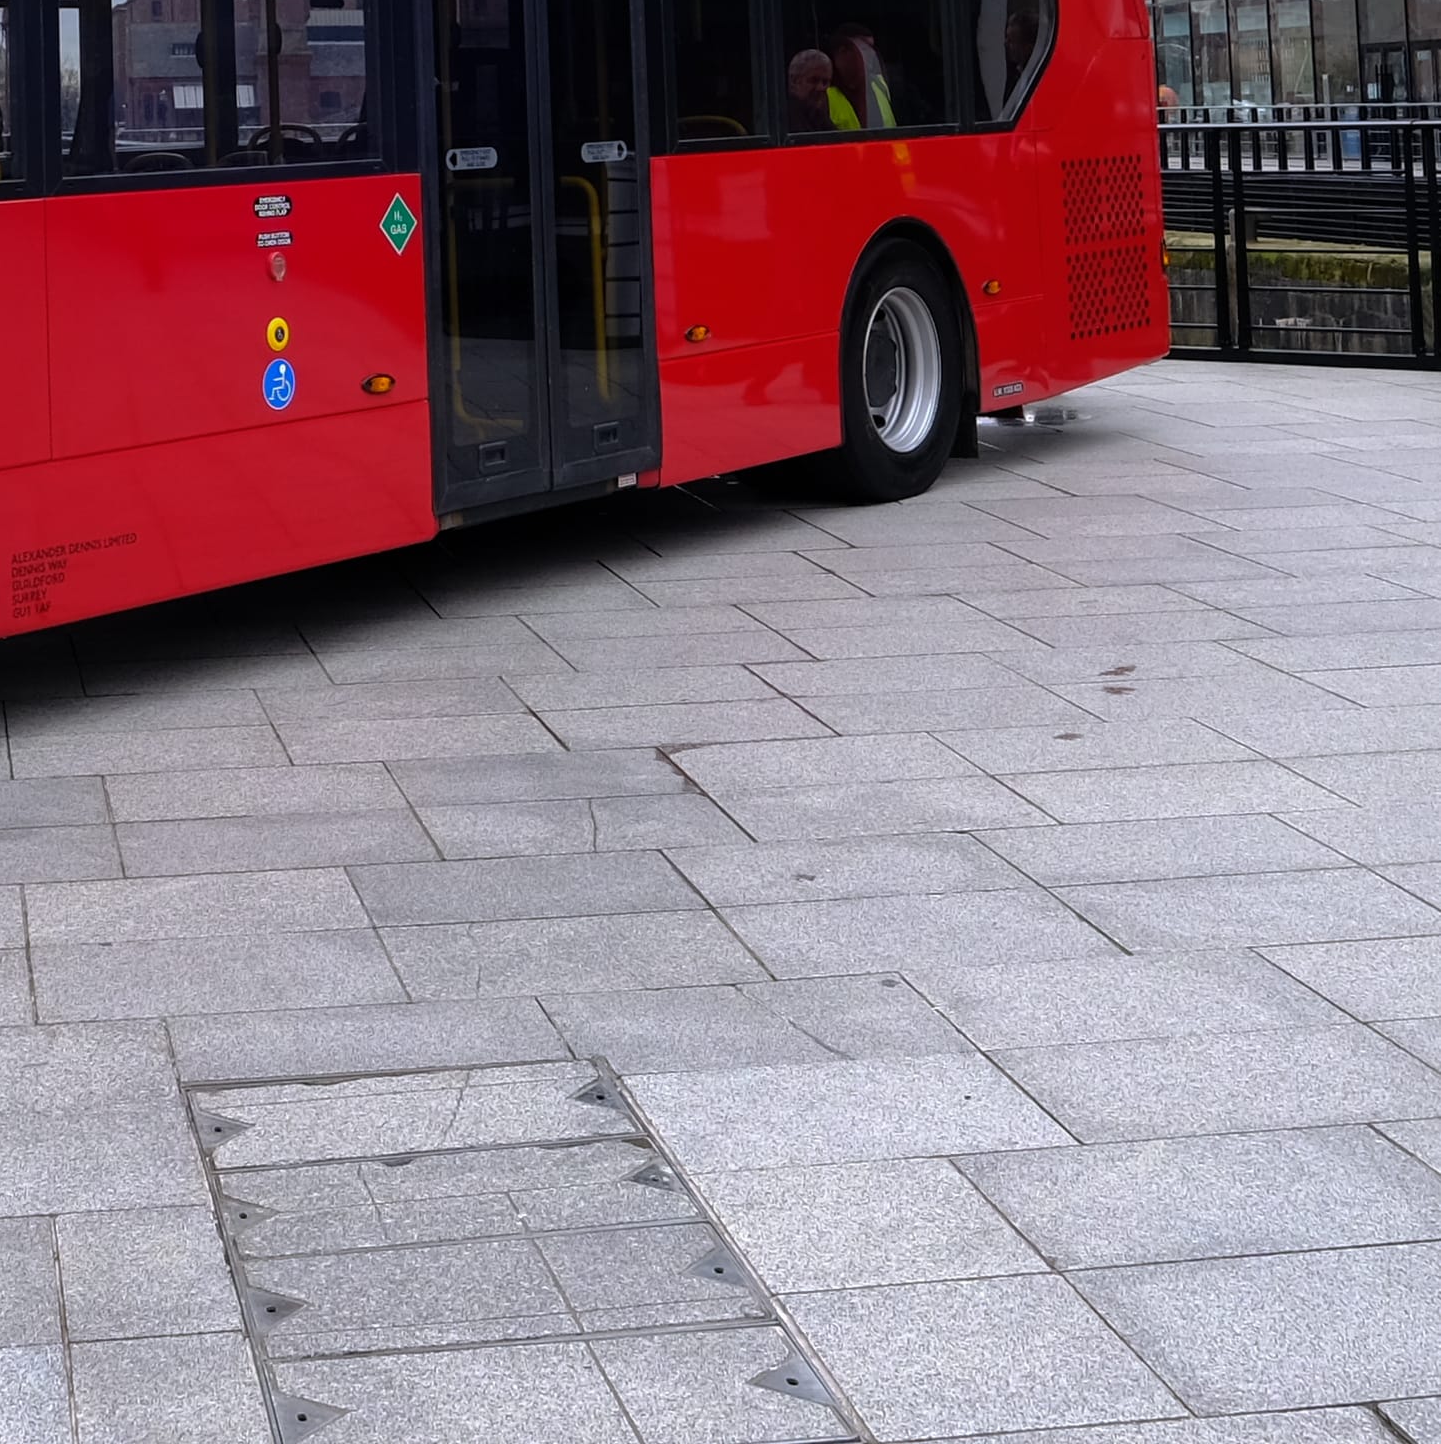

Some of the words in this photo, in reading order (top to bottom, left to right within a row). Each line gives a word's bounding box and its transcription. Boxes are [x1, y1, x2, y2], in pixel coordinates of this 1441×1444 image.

[390, 223, 408, 235] GAS
[11, 545, 66, 565] ALEXANDER
[68, 539, 102, 555] DENNIS
[103, 532, 137, 549] LIMITED
[11, 562, 46, 578] DENNIS
[47, 559, 68, 571] WAY
[12, 572, 65, 591] GUILDFORD
